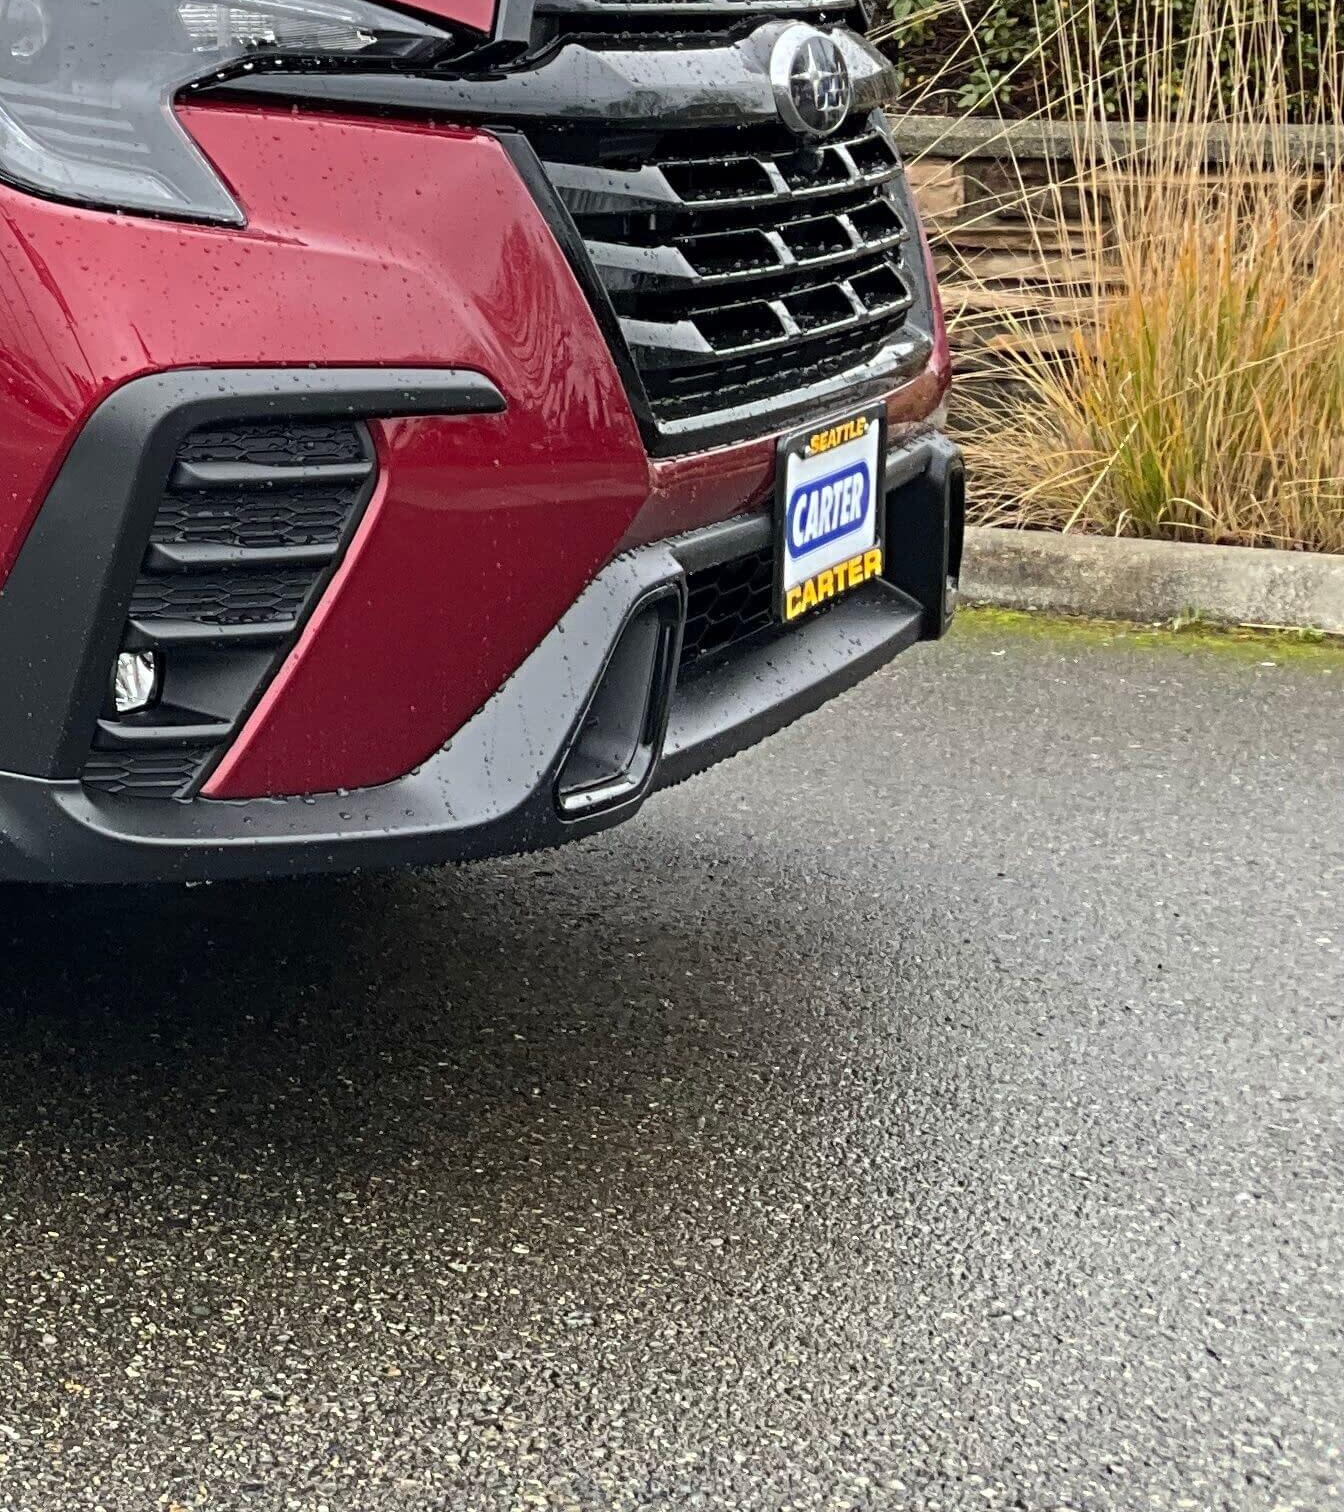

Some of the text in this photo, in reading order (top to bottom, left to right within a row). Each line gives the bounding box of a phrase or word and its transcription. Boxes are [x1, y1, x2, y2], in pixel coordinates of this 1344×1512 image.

[810, 417, 867, 452] SEATTLE
[792, 472, 863, 548] CARTER
[785, 548, 883, 621] CARTER
